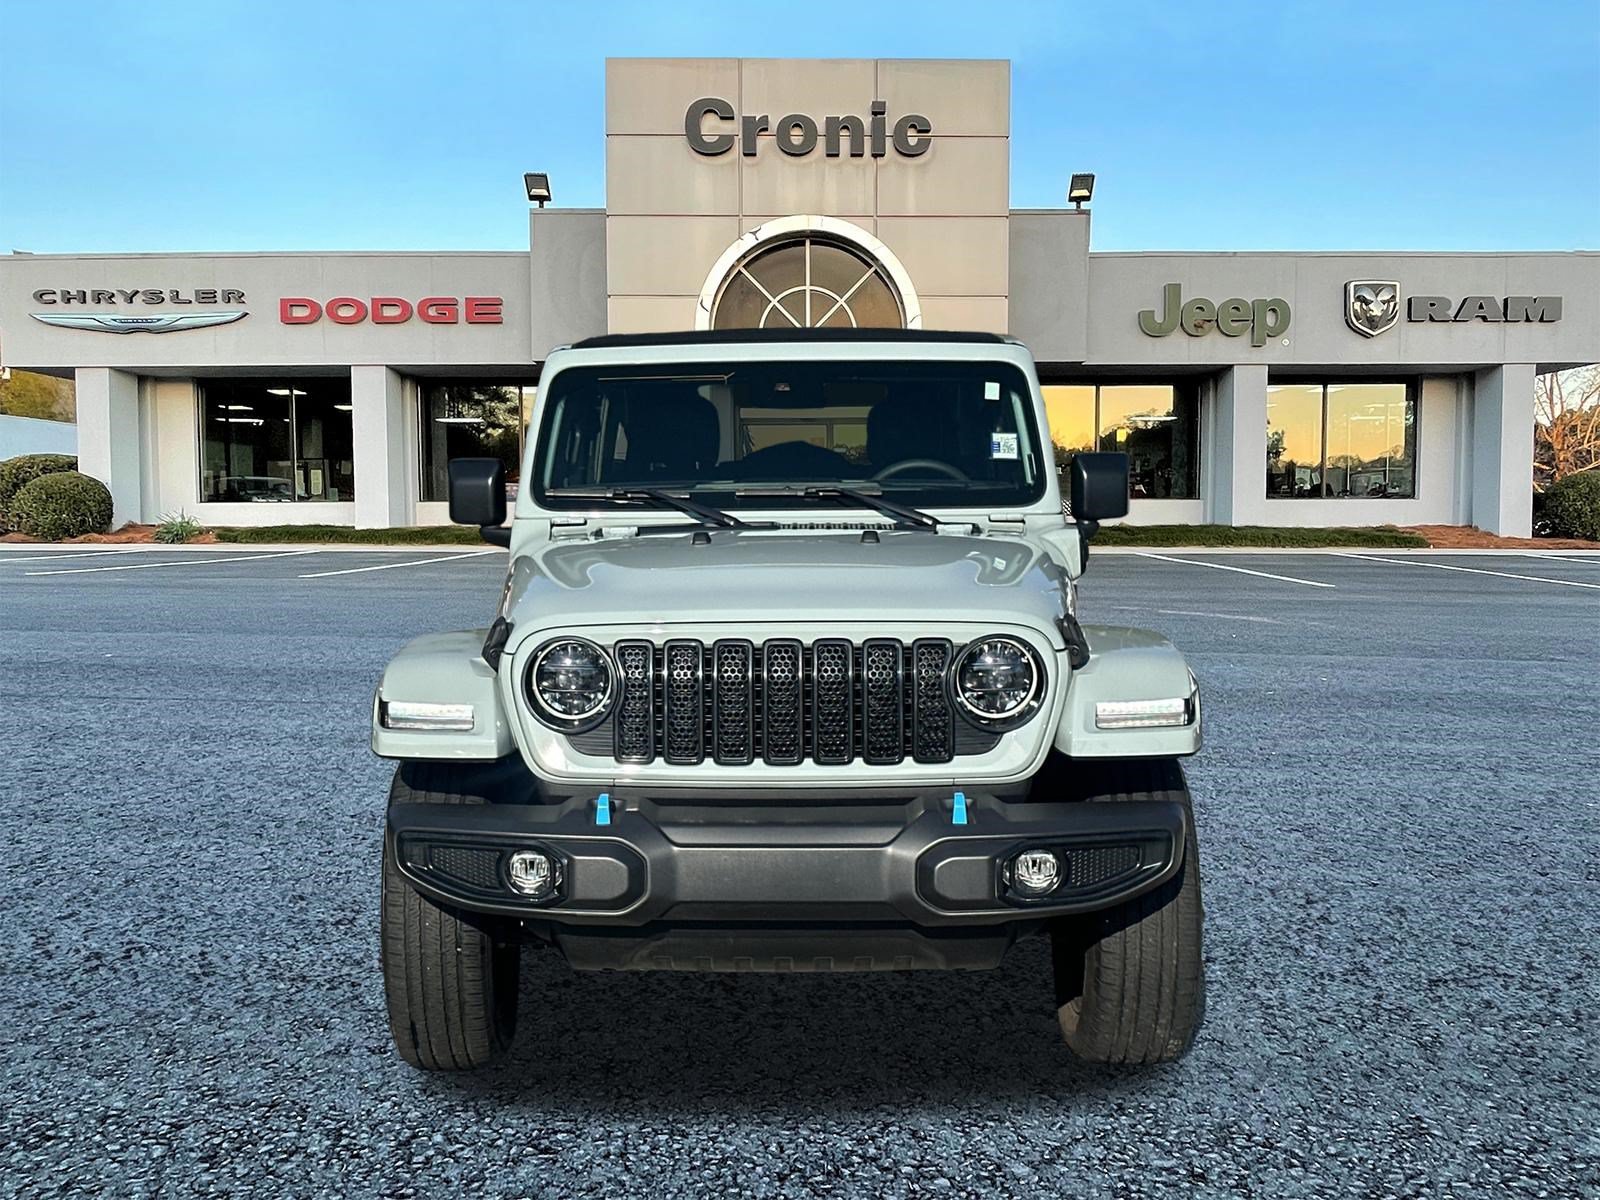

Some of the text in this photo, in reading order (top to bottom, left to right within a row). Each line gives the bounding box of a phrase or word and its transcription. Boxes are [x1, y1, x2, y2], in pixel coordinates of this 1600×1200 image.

[684, 97, 932, 157] Cronic
[32, 289, 247, 305] CHRYSLER
[279, 297, 504, 325] DODGE
[1407, 296, 1563, 323] RAM
[1138, 283, 1292, 348] Jeep
